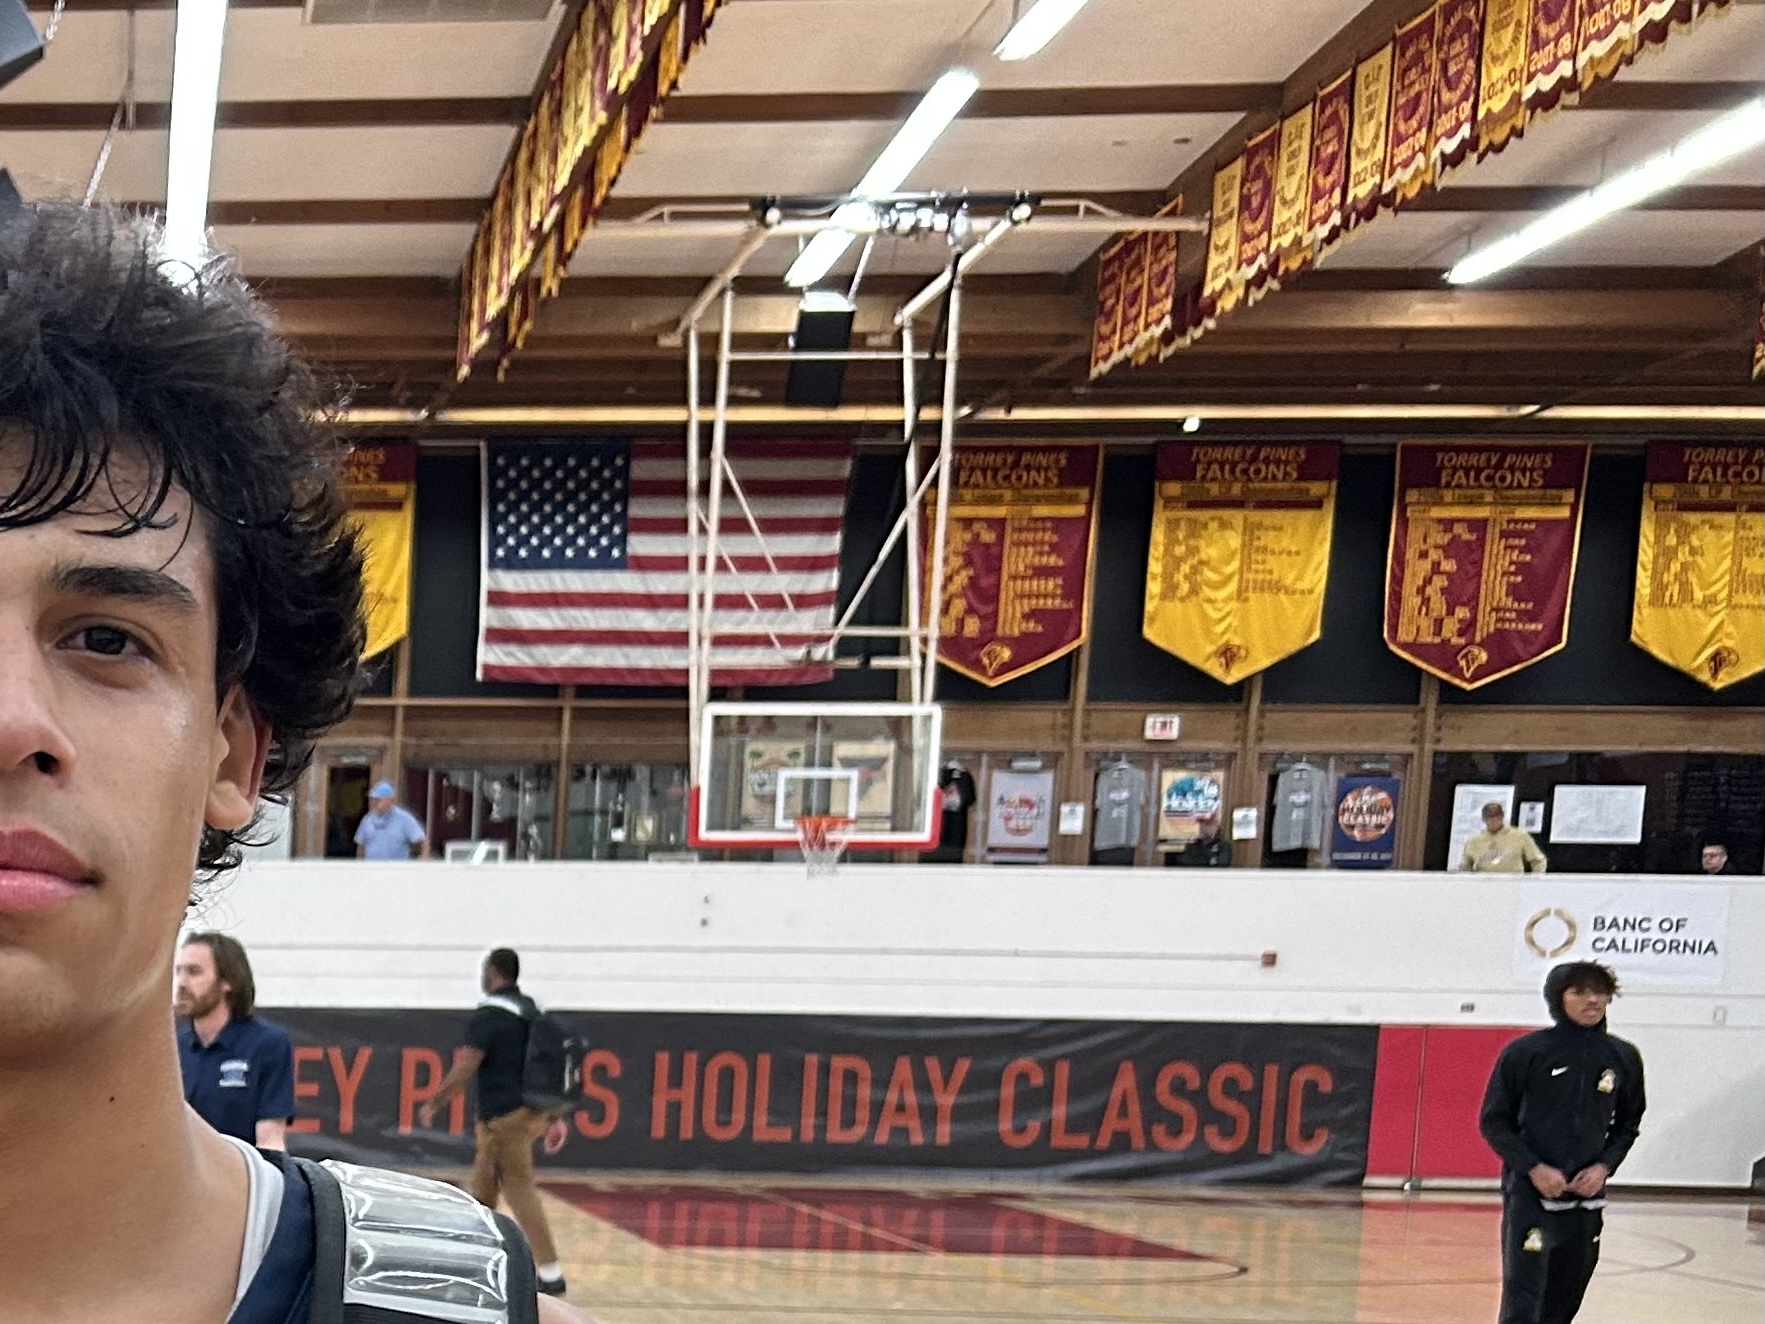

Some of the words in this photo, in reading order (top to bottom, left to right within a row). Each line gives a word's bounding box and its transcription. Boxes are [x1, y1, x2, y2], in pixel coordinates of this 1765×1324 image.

[1261, 447, 1307, 462] PINES
[1435, 452, 1499, 468] TORREY
[1503, 453, 1554, 469] PINES
[1683, 448, 1748, 464] TORREY
[958, 470, 1061, 488] FALCONS
[1196, 463, 1299, 481] FALCONS
[1440, 470, 1545, 488] FALCONS
[1687, 465, 1765, 483] FALCO
[1592, 915, 1652, 932] BANC
[1658, 917, 1689, 933] OF
[1591, 936, 1719, 956] CALIFORNIA
[398, 1046, 623, 1140] PIS
[650, 1050, 972, 1147] HOLIDAY
[997, 1056, 1334, 1157] CLASSIC
